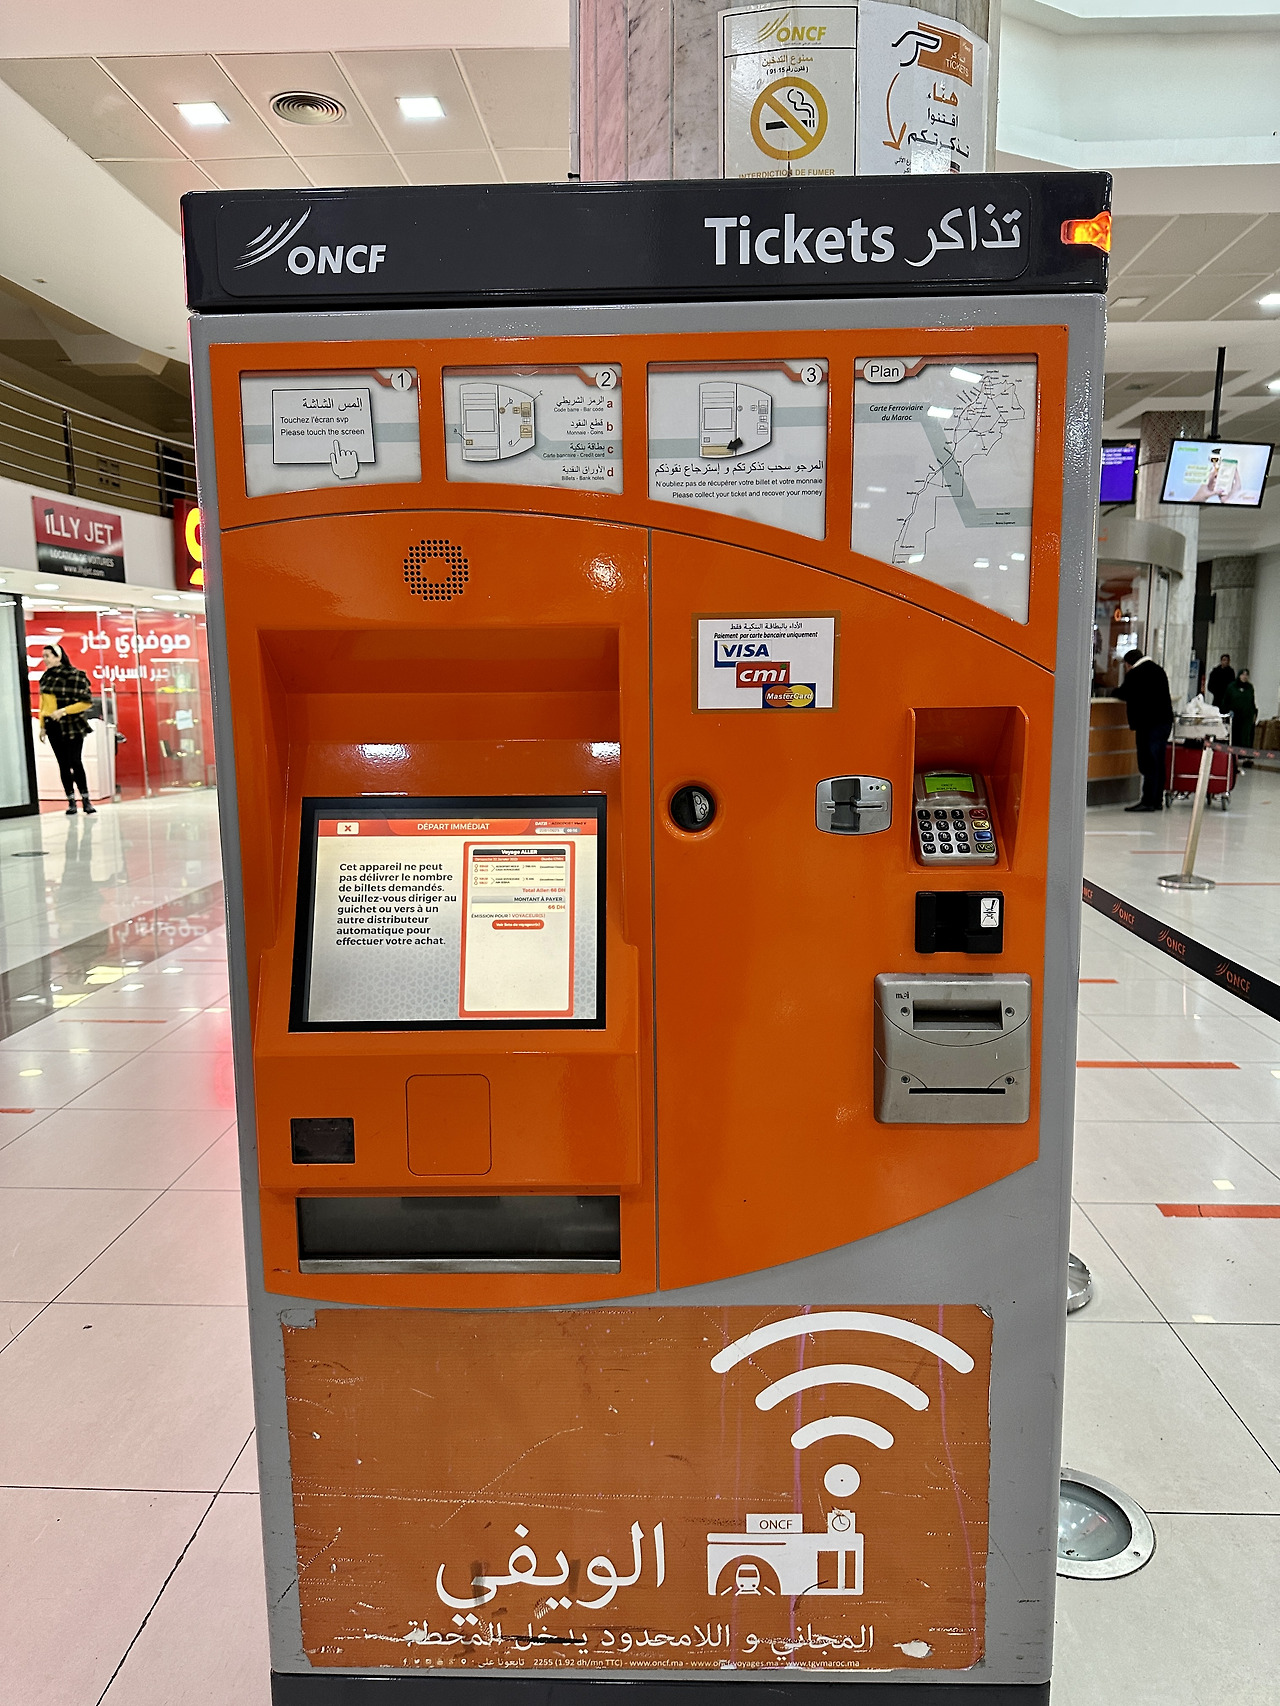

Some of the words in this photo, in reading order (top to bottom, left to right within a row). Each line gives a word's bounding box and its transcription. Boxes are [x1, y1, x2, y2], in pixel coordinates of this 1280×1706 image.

[777, 26, 827, 42] ONCF
[762, 54, 788, 67] التدخين
[791, 54, 813, 65] ممنوع
[946, 59, 969, 77] TICKETS
[928, 107, 958, 127] اقتنوا
[908, 130, 969, 158] تذكرتكم
[704, 213, 895, 265] Tickets
[904, 203, 1022, 267] تذاكر
[288, 244, 386, 275] ONCF
[806, 368, 817, 382] 3
[870, 366, 899, 377] Plan
[397, 373, 405, 387] 1
[601, 372, 611, 386] 2
[302, 397, 333, 408] الشاشة
[588, 396, 604, 405] الرمز
[607, 400, 613, 408] a
[336, 416, 349, 424] svp
[571, 419, 587, 428] النقود
[590, 419, 603, 429] قطع
[607, 422, 613, 431] b
[570, 443, 585, 452] بنكية
[588, 443, 605, 451] بطاقة
[562, 466, 580, 474] النقدية
[582, 464, 605, 474] الأوراق
[607, 467, 613, 476] d
[732, 462, 764, 475] تذكرتكم
[794, 460, 823, 472] المرجو
[84, 521, 114, 545] JET
[88, 556, 114, 568] VOITURES
[80, 630, 110, 654] كار
[115, 630, 191, 658] صوفوي
[722, 644, 769, 657] VISA
[93, 665, 147, 681] السيارات
[740, 664, 787, 682] cmi
[359, 862, 401, 872] appareil
[419, 863, 443, 872] peut
[339, 875, 357, 883] pas
[360, 873, 399, 881] délivrer
[339, 884, 352, 892] de
[389, 883, 444, 891] demandés.
[339, 894, 406, 902] Veuillez-vous
[409, 894, 442, 903] diriger
[338, 905, 376, 915] guichet
[367, 915, 429, 923] distributeur
[1119, 909, 1135, 924] ONCF
[337, 926, 404, 936] automatique
[407, 927, 431, 935] pour
[336, 937, 383, 945] effectuer
[415, 937, 445, 945] achat.
[1166, 937, 1186, 955] ONCF
[1227, 971, 1250, 992] ONCF
[759, 1520, 793, 1529] ONCF
[436, 1520, 665, 1627] الويفي
[403, 1620, 501, 1646] المحطة
[601, 1623, 730, 1652] اللامحدود
[742, 1635, 758, 1653] و
[770, 1623, 874, 1661] المجاني
[478, 1658, 494, 1667] على
[498, 1658, 524, 1668] تابعونا
[787, 1660, 859, 1668] www.tgvmaroc.ma
